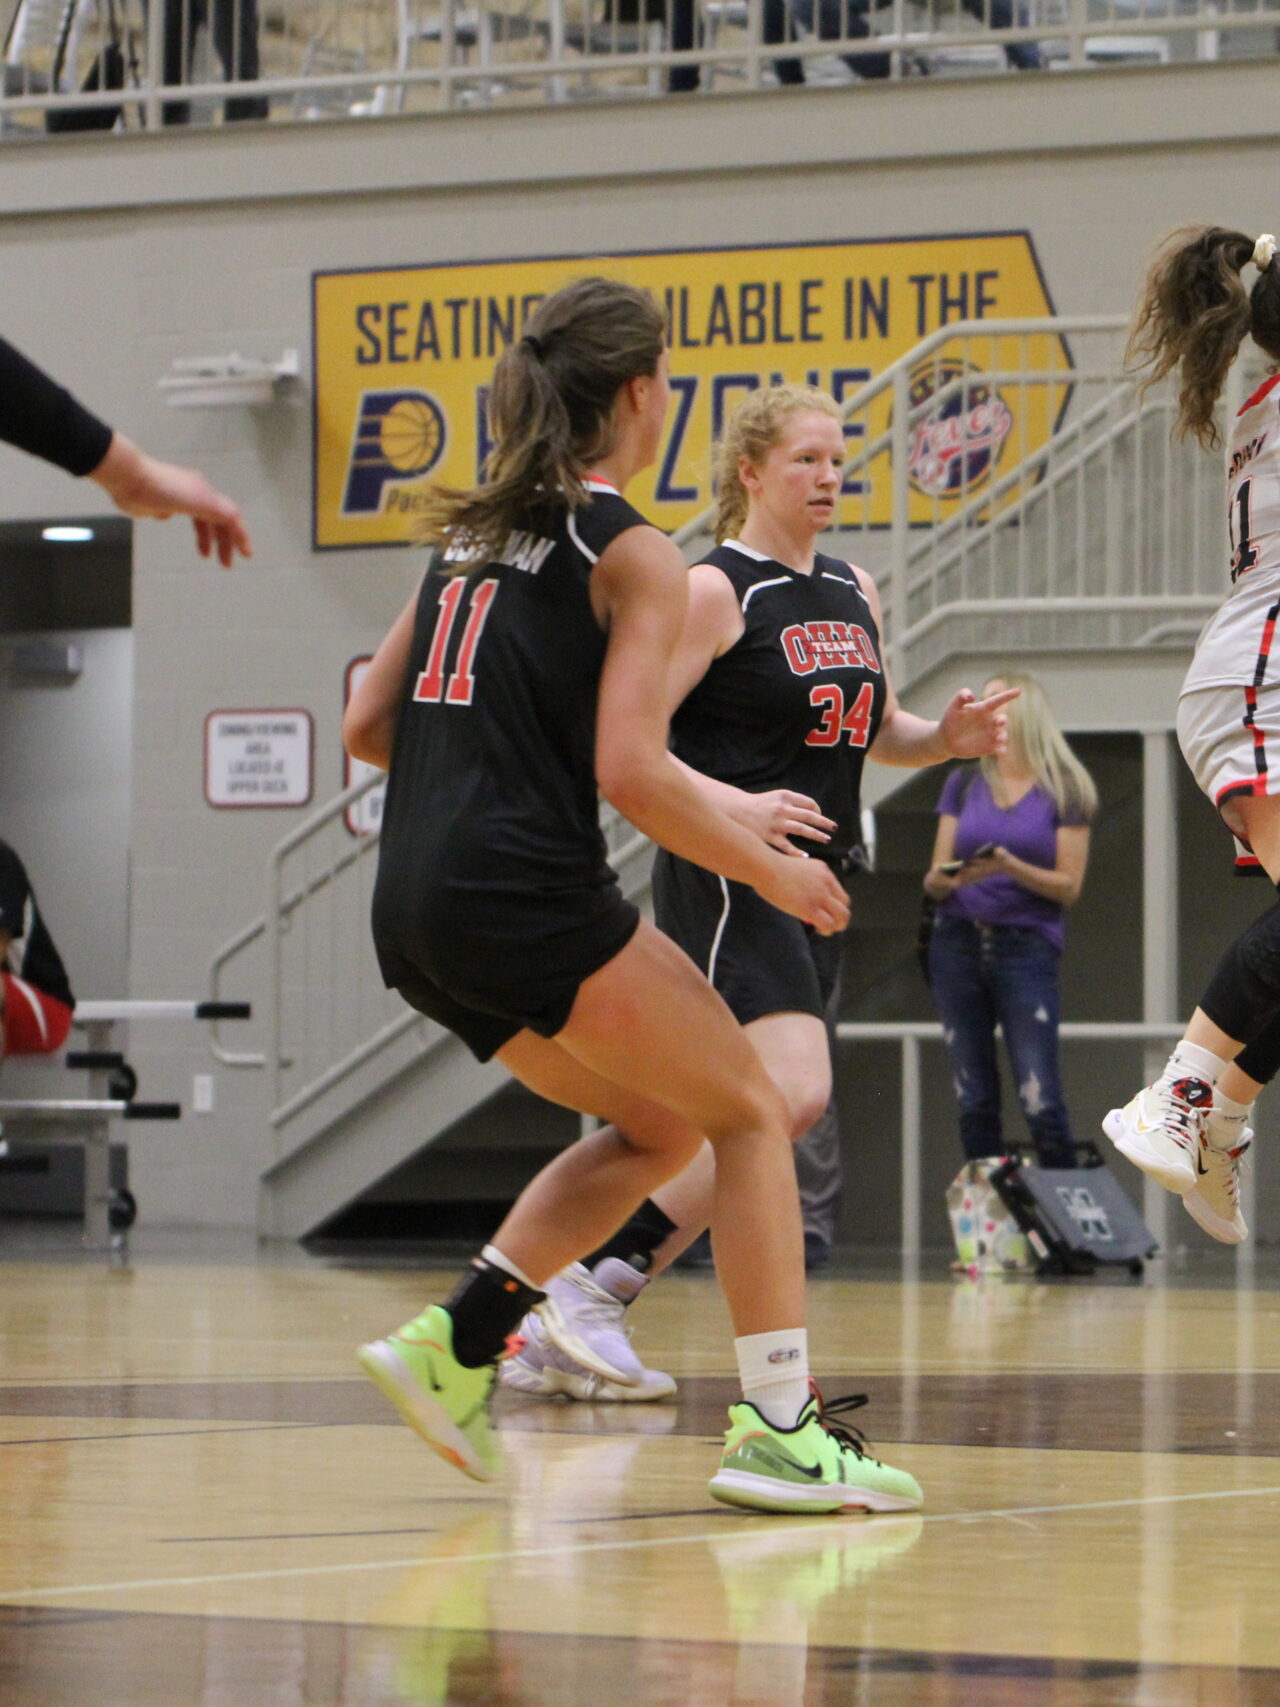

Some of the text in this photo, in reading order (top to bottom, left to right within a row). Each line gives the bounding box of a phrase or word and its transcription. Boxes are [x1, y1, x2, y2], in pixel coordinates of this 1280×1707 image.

[663, 279, 823, 348] ILABLE
[844, 276, 889, 341] IN
[908, 270, 999, 337] THE
[412, 575, 500, 706] 11
[811, 640, 857, 653] TEAM
[804, 682, 874, 748] 34
